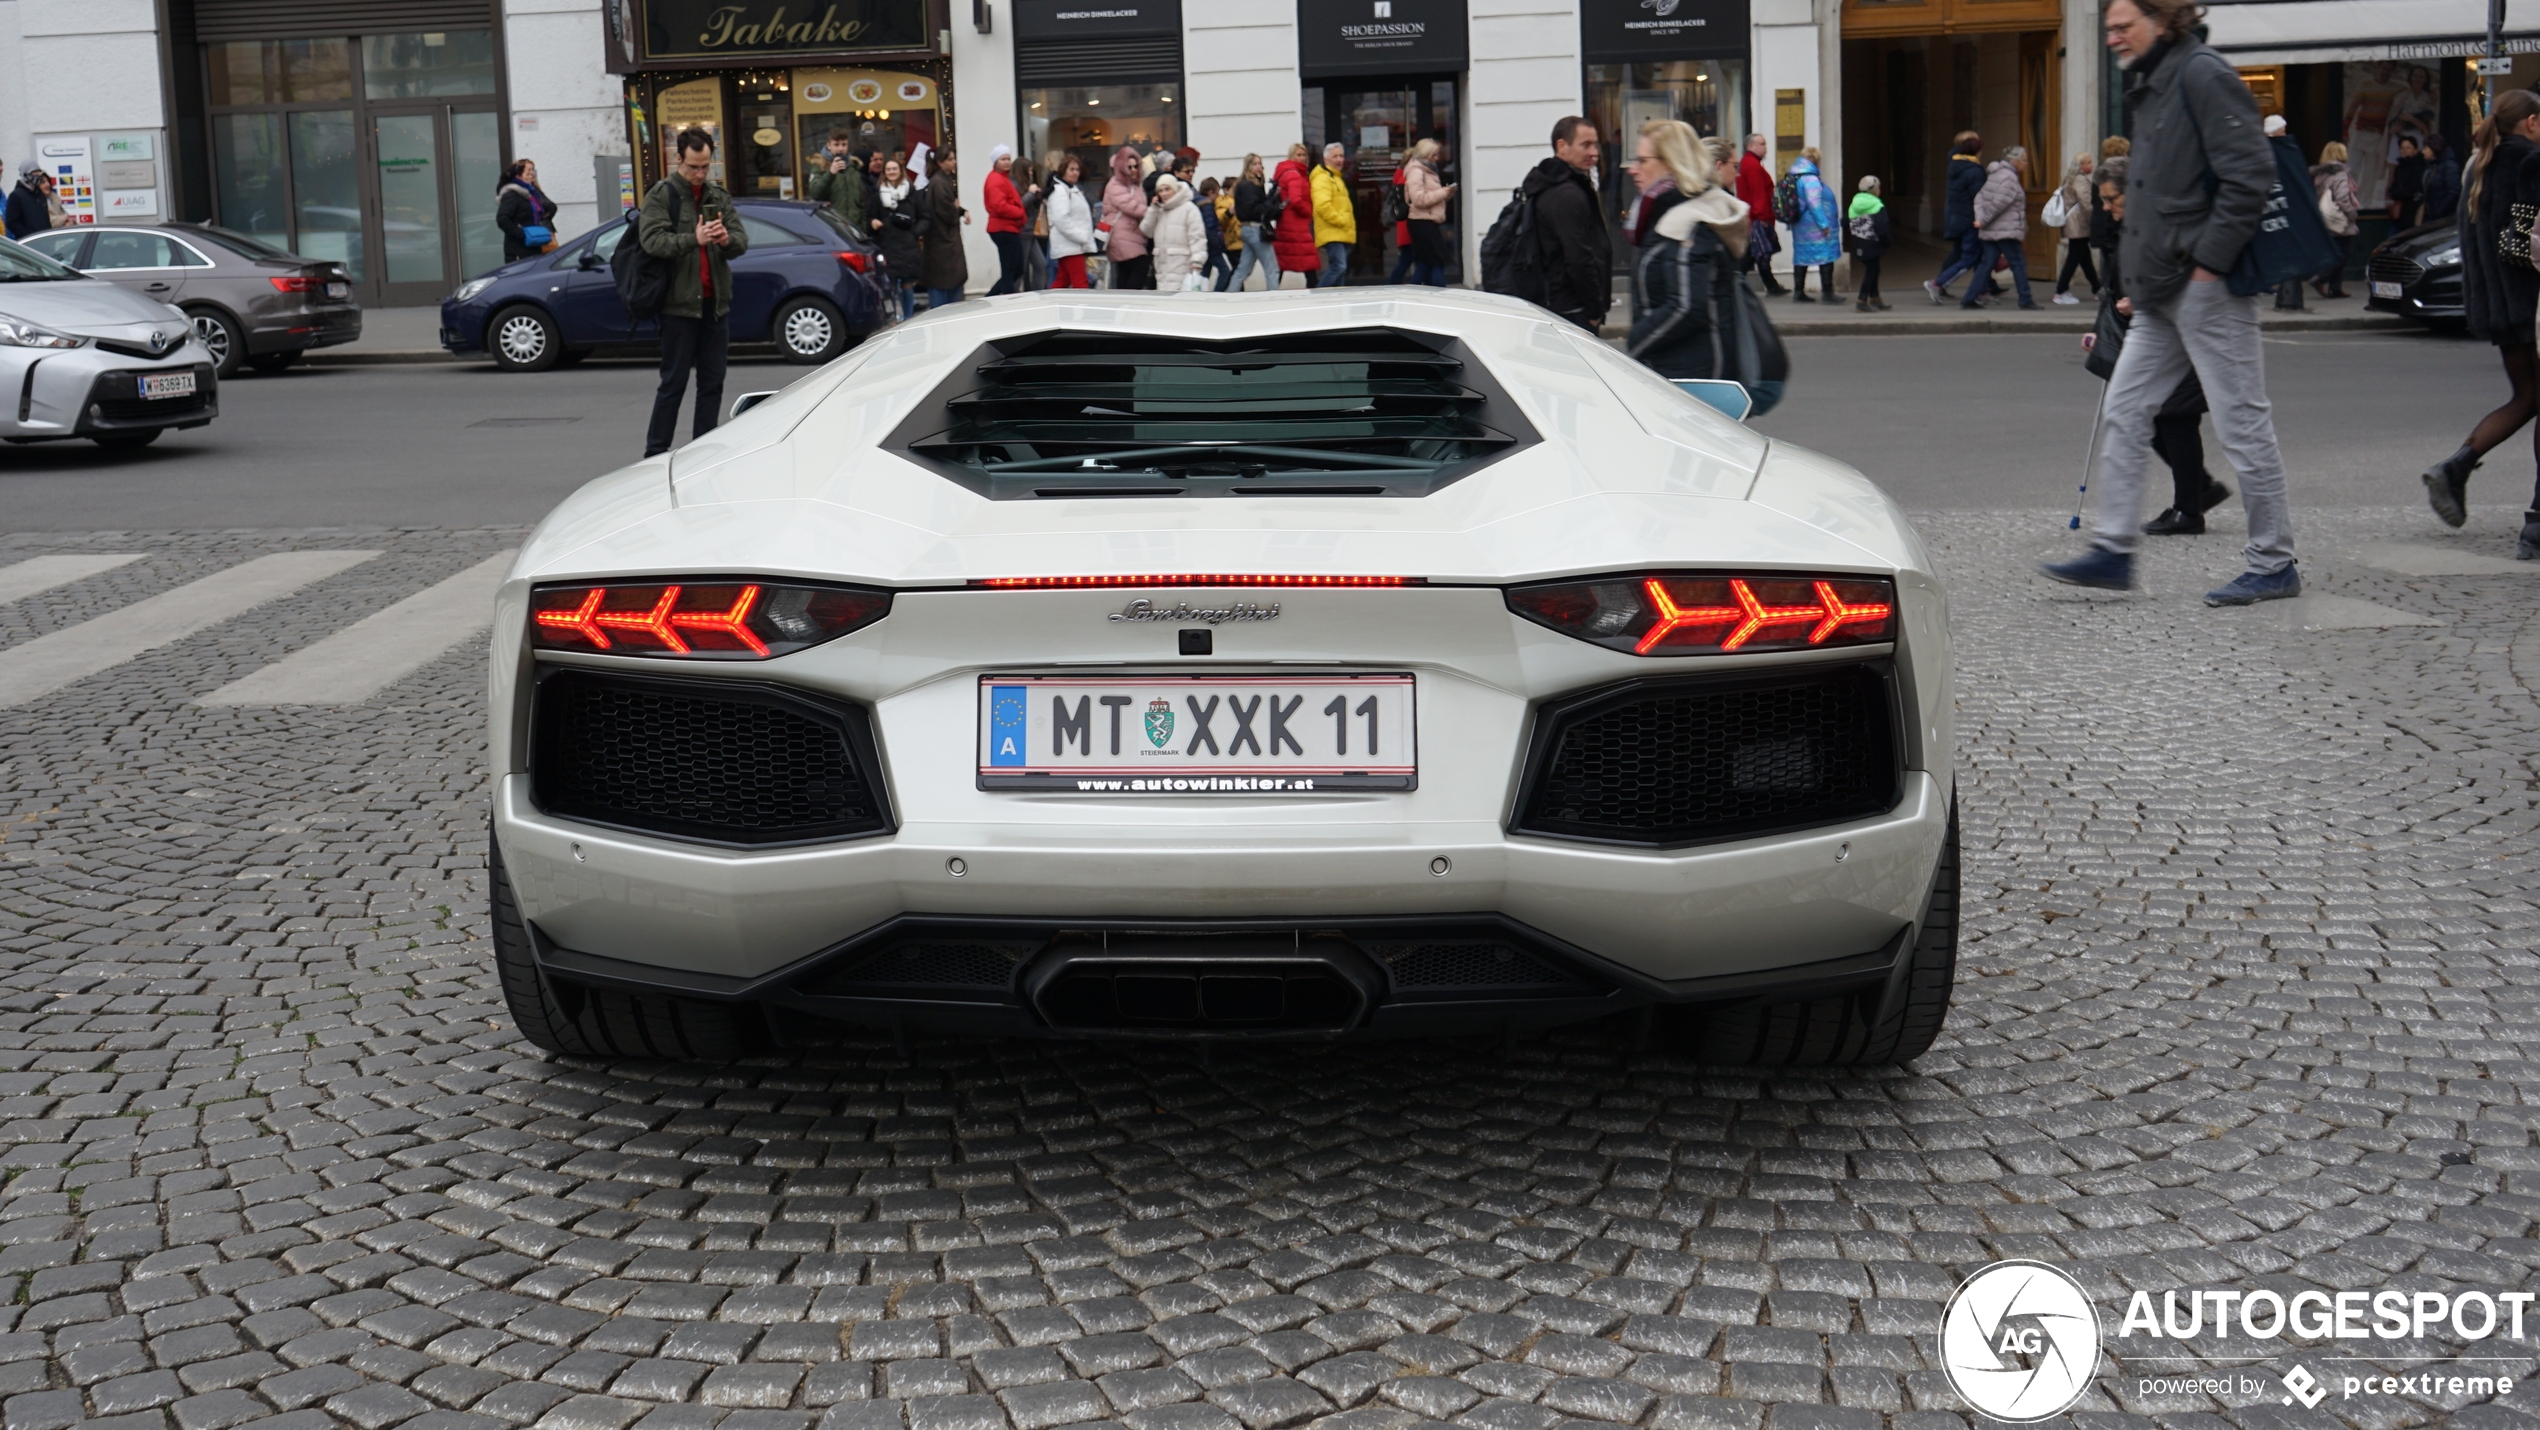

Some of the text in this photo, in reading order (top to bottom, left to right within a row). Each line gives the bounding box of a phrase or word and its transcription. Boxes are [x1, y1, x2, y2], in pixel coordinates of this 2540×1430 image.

[1056, 9, 1138, 20] HEINRICH DINKELACKER
[1624, 19, 1706, 29] HEINRICH DINKELACKER
[699, 4, 872, 47] Tabake
[1340, 22, 1425, 36] SHOEPASSION
[2387, 40, 2468, 60] Harmont
[1108, 598, 1281, 626] Lamborghini
[1000, 695, 1378, 756] A MT XXK 11
